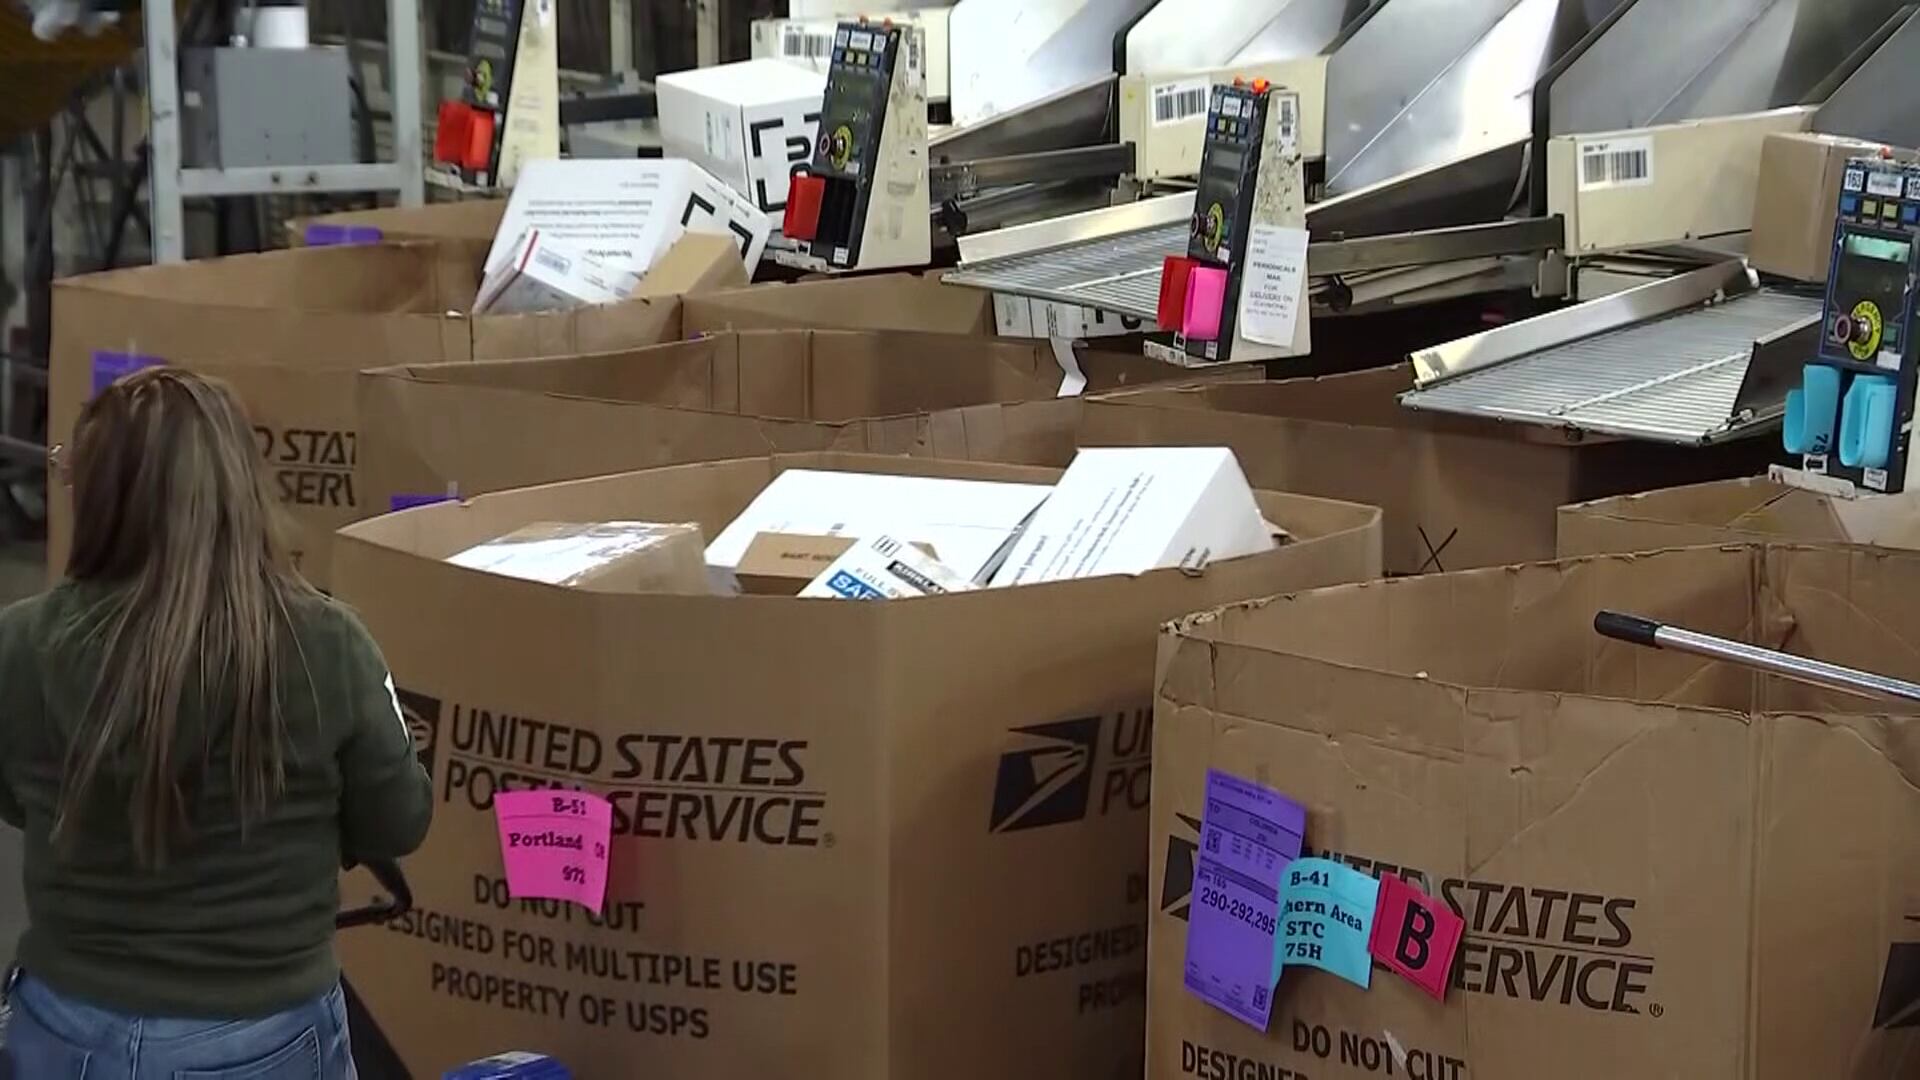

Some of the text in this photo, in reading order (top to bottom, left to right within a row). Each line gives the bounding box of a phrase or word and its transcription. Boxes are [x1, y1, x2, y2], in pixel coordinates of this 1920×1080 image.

[451, 704, 808, 787] UNITED STATES
[552, 797, 586, 815] B-51
[604, 790, 826, 847] SERVICE
[508, 831, 583, 850] Portland
[474, 873, 511, 909] DO
[1290, 870, 1330, 888] B-41
[1200, 887, 1276, 937] 290-292,295
[1285, 898, 1363, 932] hern Area
[1286, 920, 1325, 939] STC
[1441, 878, 1637, 948] STATES
[388, 907, 798, 995] SIGNED FOR MULTIPLE USE
[1285, 942, 1323, 961] 75H
[1395, 898, 1436, 971] B
[431, 961, 710, 1039] PROPERTY OF USPS
[1454, 944, 1654, 1014] ERVICE
[1293, 1019, 1332, 1058] DO
